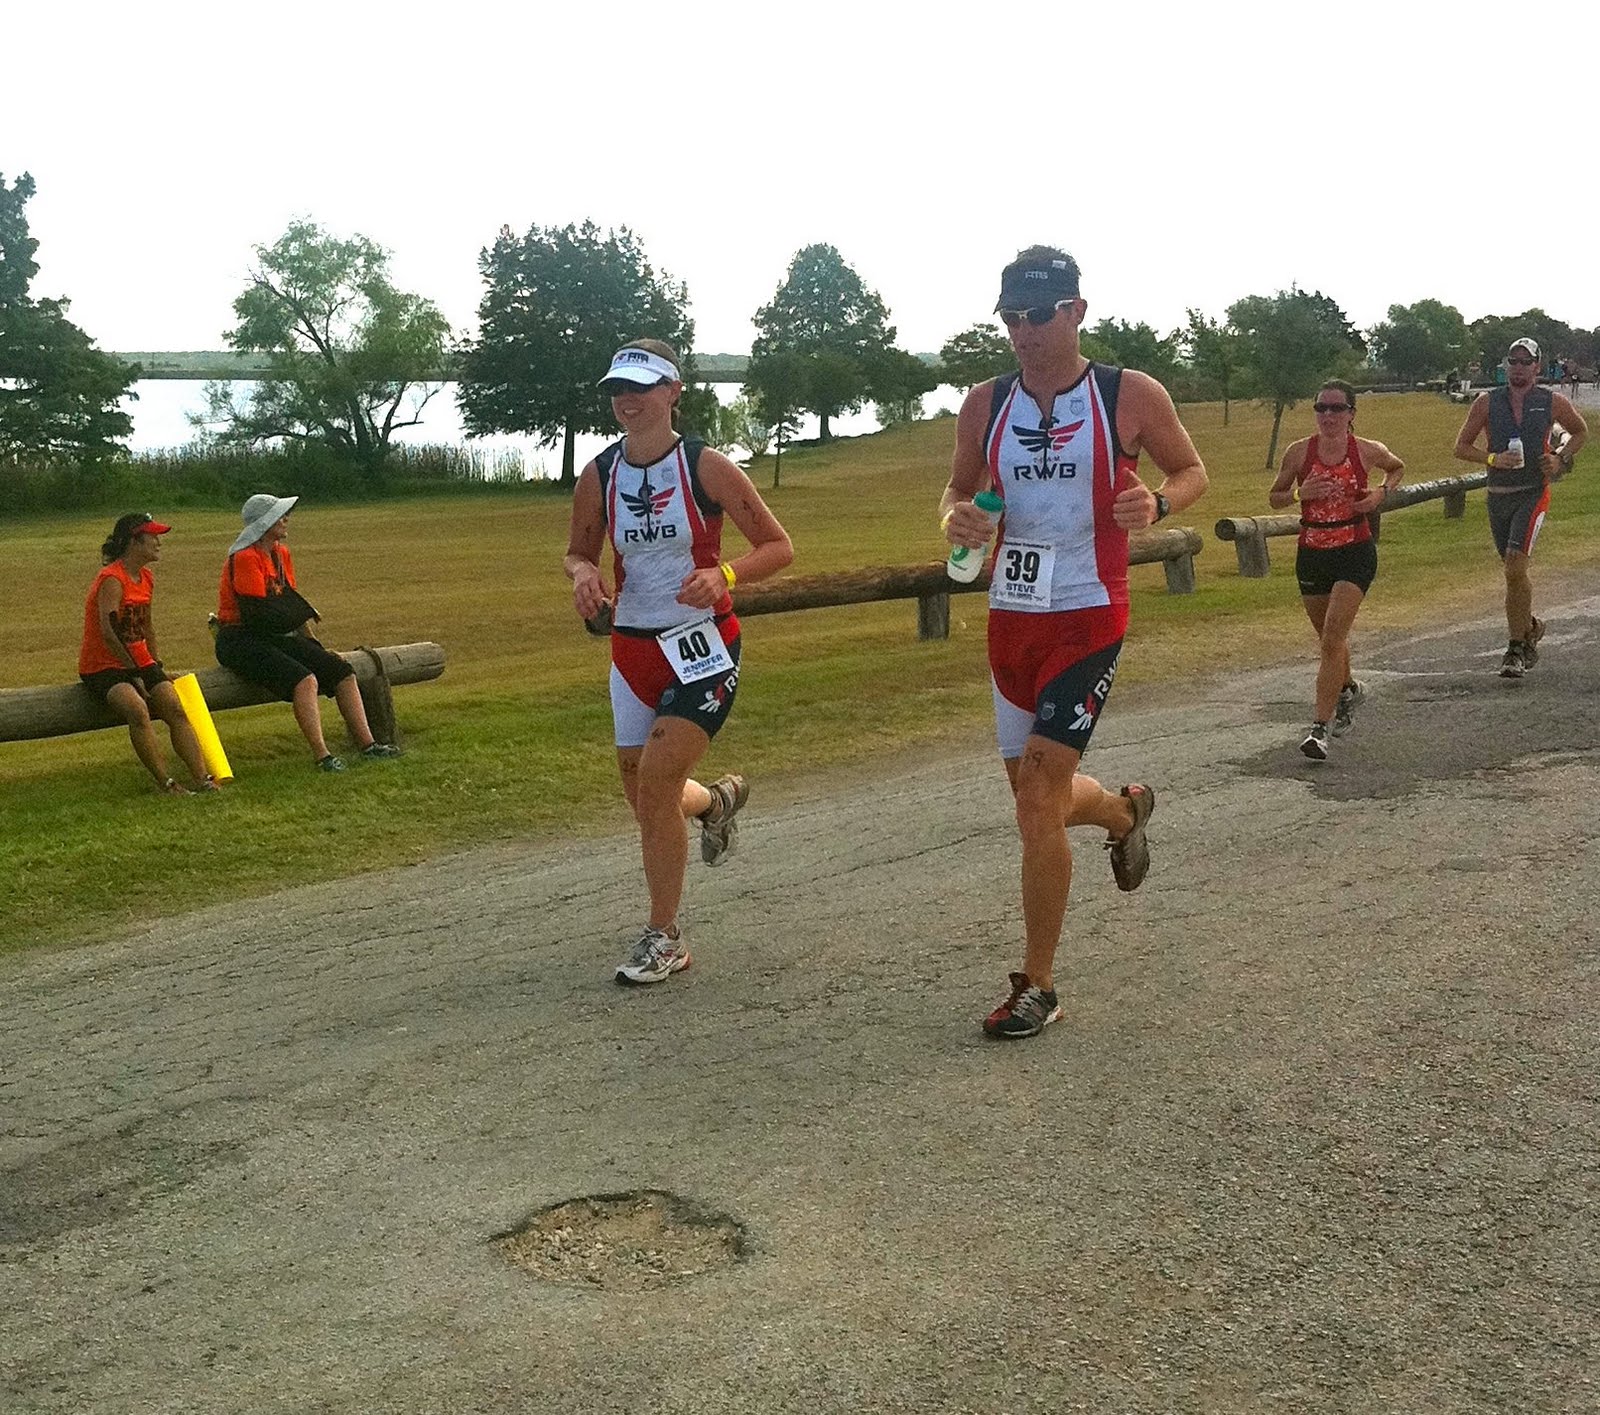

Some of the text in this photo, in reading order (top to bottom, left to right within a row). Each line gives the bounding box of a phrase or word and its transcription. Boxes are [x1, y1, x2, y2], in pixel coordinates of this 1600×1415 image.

[1013, 463, 1076, 480] RWB
[624, 524, 677, 543] RWB
[1006, 550, 1040, 583] 39
[1006, 582, 1036, 594] STEVE
[678, 630, 711, 662] 40
[682, 653, 723, 675] JENNIFER
